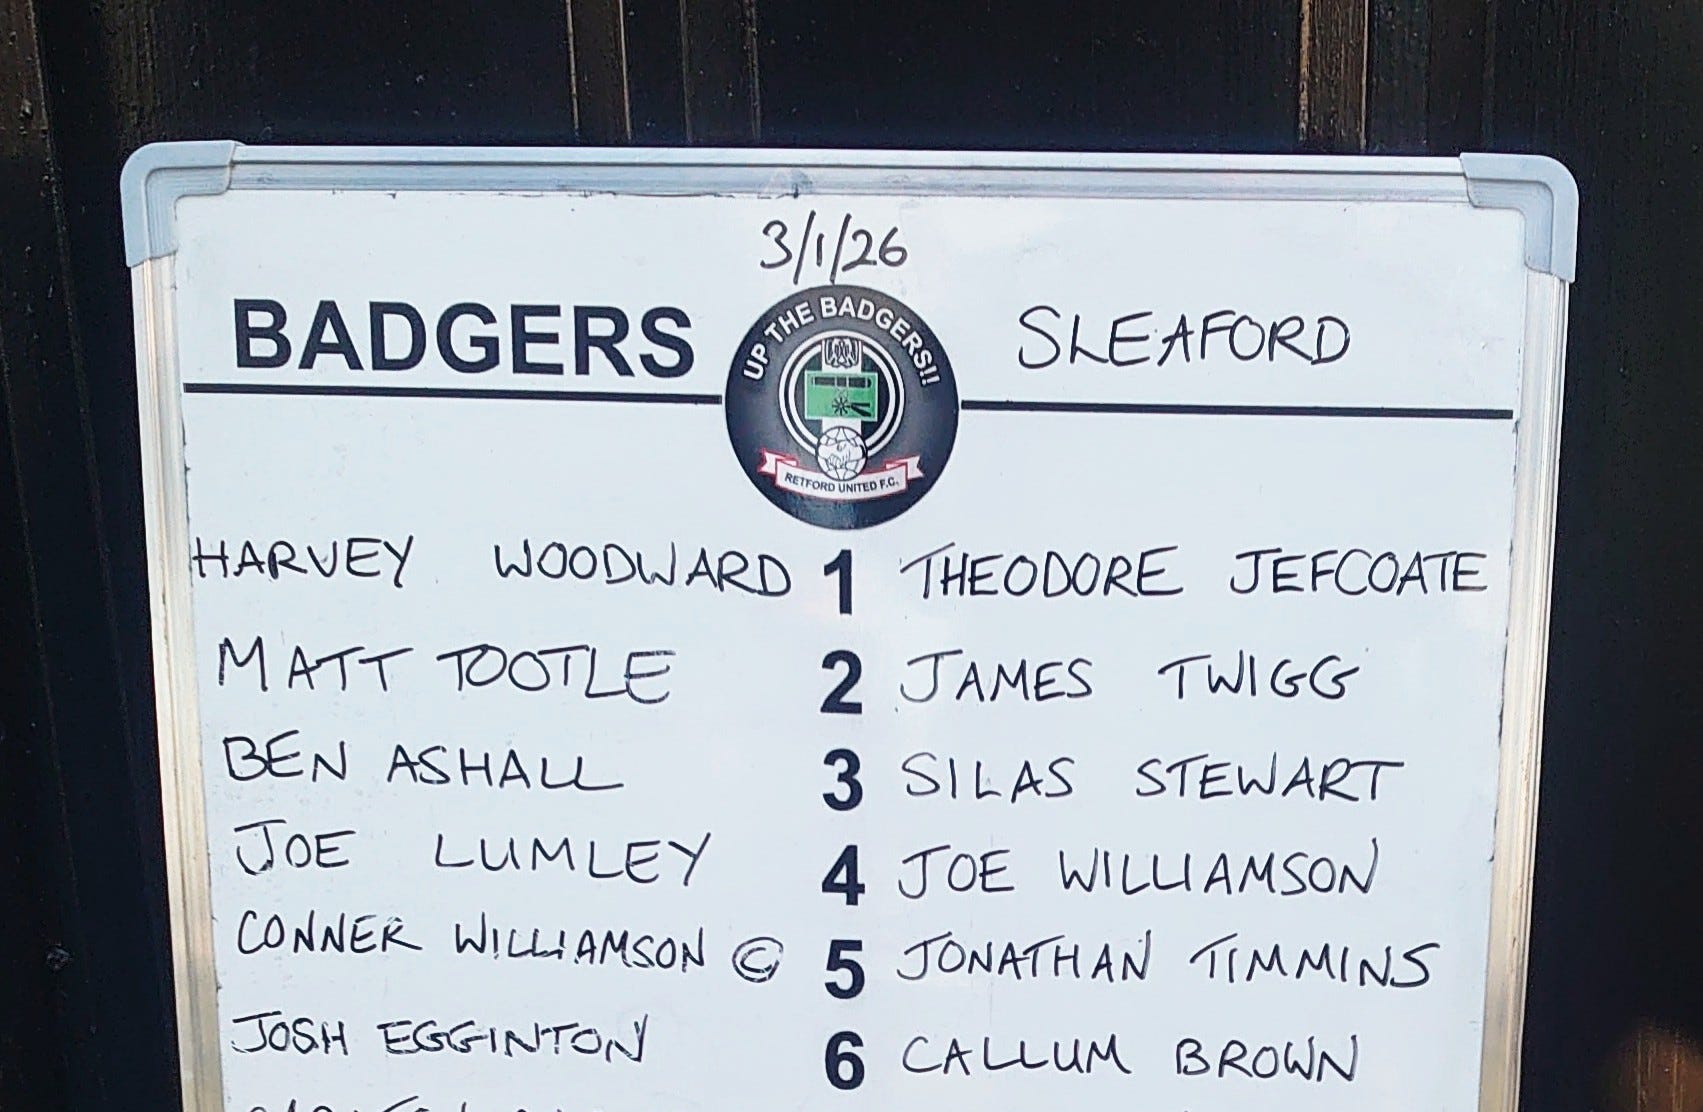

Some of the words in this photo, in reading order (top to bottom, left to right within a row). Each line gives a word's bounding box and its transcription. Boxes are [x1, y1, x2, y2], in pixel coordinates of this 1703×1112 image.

[760, 210, 908, 284] 3/1/26
[234, 298, 694, 379] BADGERS
[743, 343, 769, 381] UP
[763, 302, 815, 343] THE
[820, 296, 941, 387] BADGERS!!
[1018, 305, 1350, 369] SLEAFORD
[784, 473, 835, 492] RETFORD
[838, 482, 877, 493] UNITED
[880, 477, 899, 490] F.C.
[188, 535, 414, 588] HARVEY
[494, 538, 791, 597] WOODWARD
[824, 549, 852, 616] 1
[900, 542, 1184, 599] THEODORE
[1230, 547, 1488, 596] JEFCOATE
[219, 636, 414, 692] MATT
[436, 643, 676, 704] TOOTLE
[820, 649, 862, 715] 2
[900, 649, 1092, 703] JAMES
[1158, 649, 1360, 700] TWIGG
[222, 730, 346, 782] BEN
[387, 744, 624, 791] ASHALL
[823, 748, 863, 811] 3
[901, 752, 1075, 804] SILAS
[1136, 752, 1404, 802] STEWART
[234, 819, 356, 876] JOE
[435, 832, 711, 887] LUMLEY
[822, 844, 865, 906] 4
[898, 844, 1015, 899] JOE
[1059, 837, 1378, 896] WILLIAMSON
[237, 910, 423, 954] CONNER
[455, 912, 704, 973] WILLIAMSON
[825, 939, 865, 1000] 5
[897, 929, 1151, 983] JONATHAN
[1189, 933, 1440, 988] TIMMINS
[232, 1010, 348, 1056] JOSH
[376, 1014, 648, 1063] EGGINTON
[825, 1031, 865, 1090] 6
[902, 1034, 1132, 1076] CALLUM
[1176, 1034, 1358, 1082] BROWN
